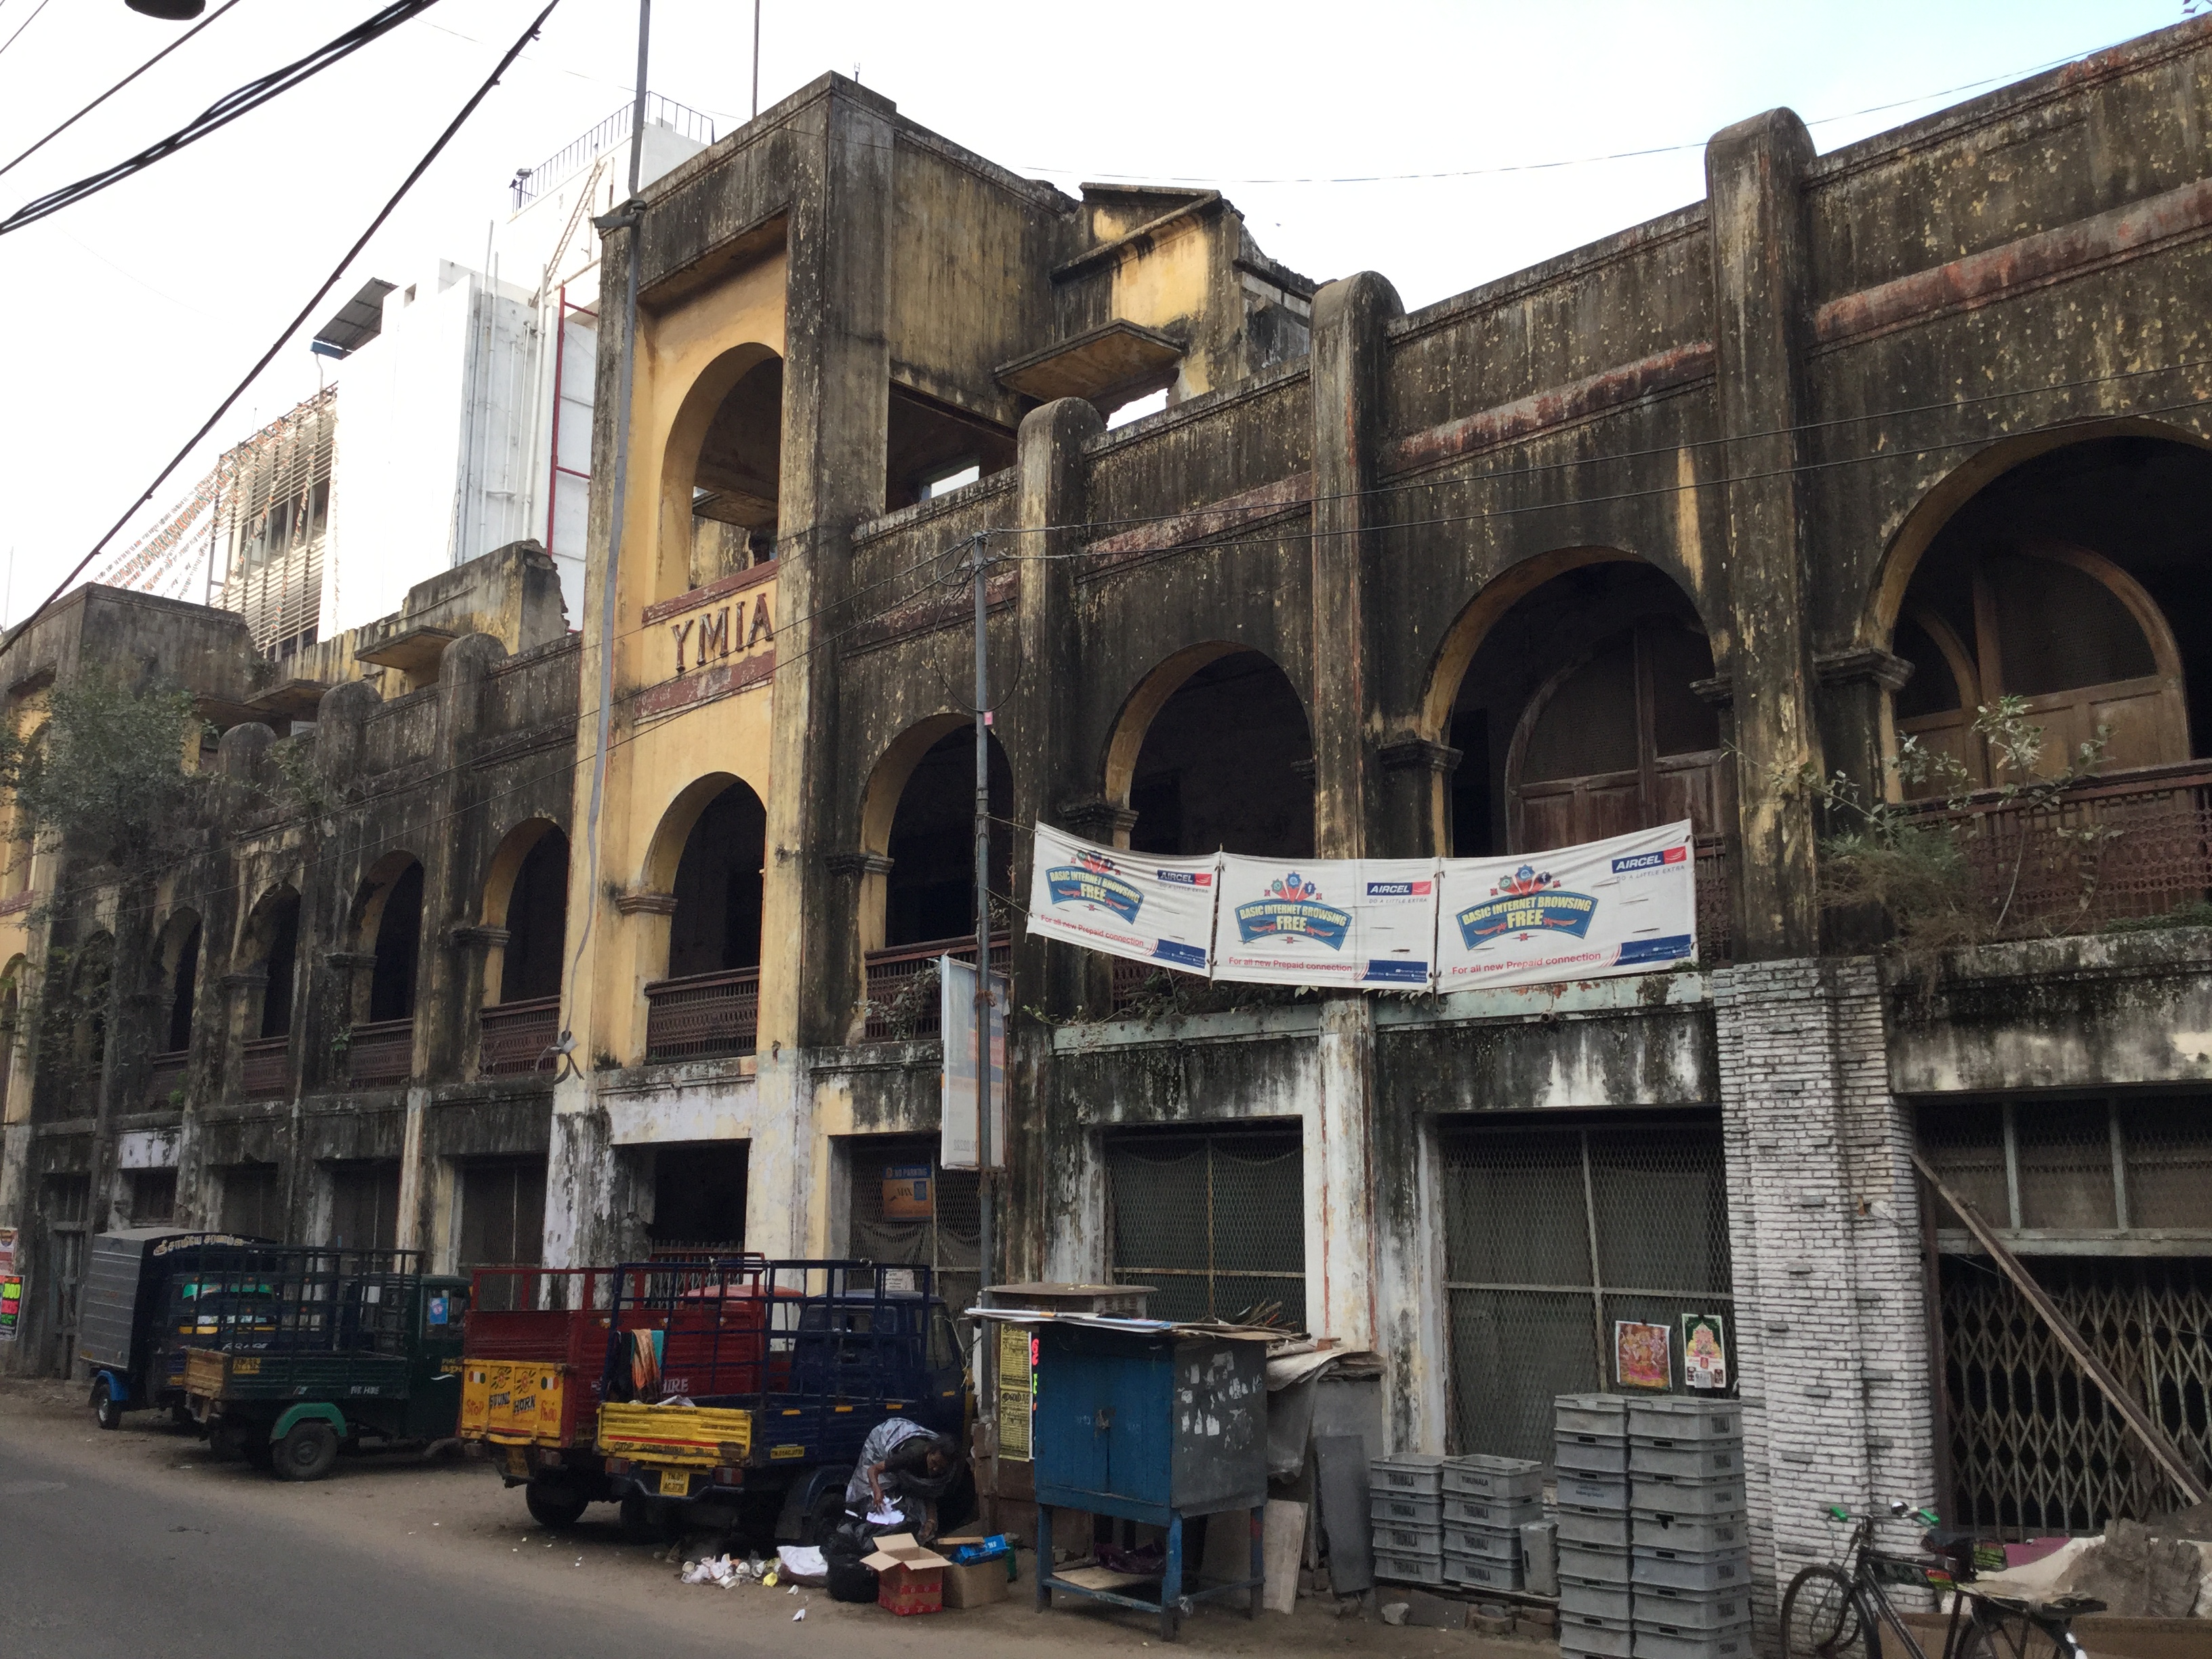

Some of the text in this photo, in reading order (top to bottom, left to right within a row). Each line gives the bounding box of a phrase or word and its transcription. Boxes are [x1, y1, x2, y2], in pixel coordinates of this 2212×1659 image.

[671, 593, 773, 672] YMIA
[1616, 855, 1661, 870] AIRCEL
[1636, 869, 1660, 878] LITTLE
[1662, 865, 1685, 874] EXTRA
[1160, 872, 1193, 882] AIRCEL
[1050, 871, 1140, 904] BASIC INTERNET BROWSING
[1080, 882, 1107, 903] FREE
[1370, 885, 1410, 893] AIRCEL
[1240, 904, 1347, 926] BASIC INTERNET BROWSING
[1462, 897, 1591, 926] BASIC INTERNET BROWSING
[1507, 909, 1544, 928] FREE
[1041, 914, 1051, 923] For
[1063, 922, 1076, 930] new
[1078, 924, 1104, 937] Prepaid
[1105, 932, 1144, 947] connection
[1276, 916, 1307, 932] FREE
[1229, 957, 1241, 965] For
[1273, 960, 1304, 971] Prepaid
[1306, 963, 1352, 972] connection
[1452, 952, 1601, 975] For all new Prepaid connection
[513, 1394, 536, 1414] HORN
